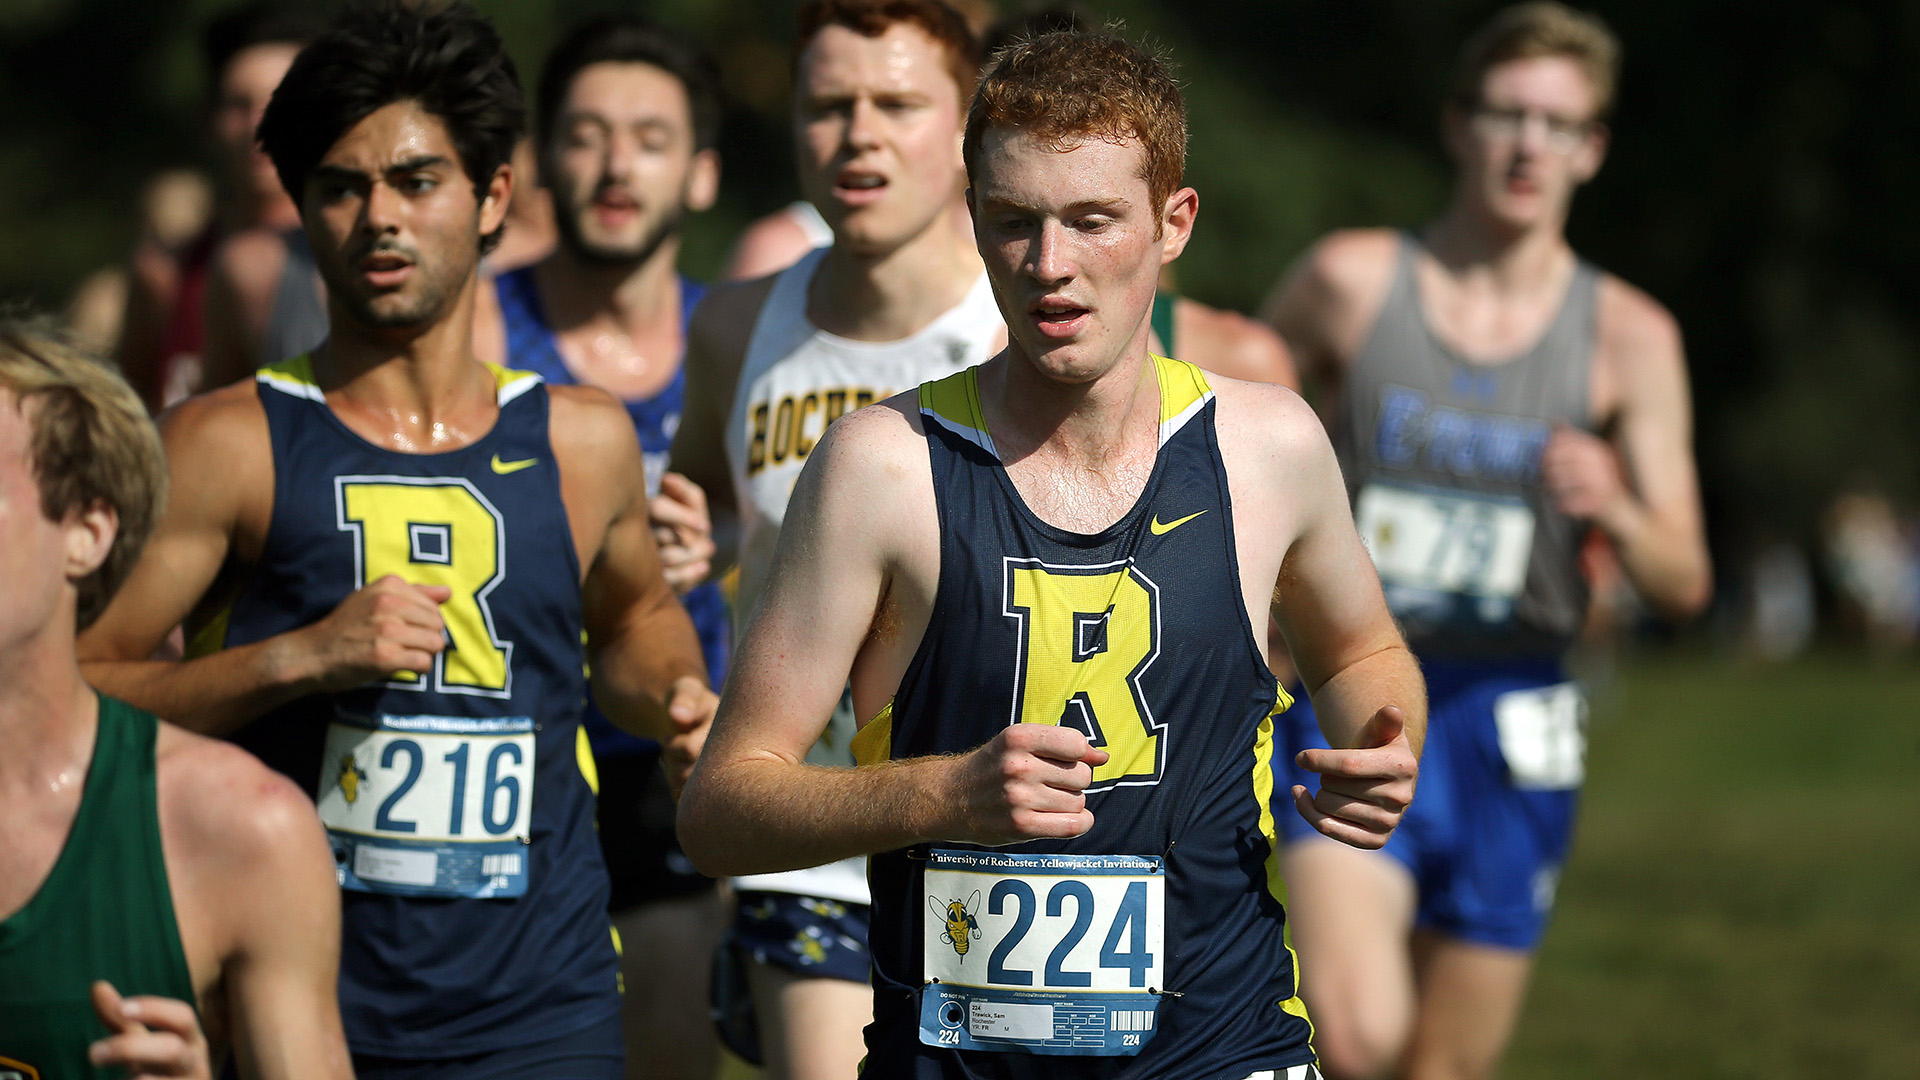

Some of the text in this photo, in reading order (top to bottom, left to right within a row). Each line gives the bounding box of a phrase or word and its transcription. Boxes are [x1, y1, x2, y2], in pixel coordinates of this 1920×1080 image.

[747, 384, 893, 477] ROCH
[334, 475, 514, 699] R
[1002, 556, 1169, 794] R
[374, 739, 523, 835] 216
[979, 856, 990, 866] of
[990, 857, 1039, 868] Rochester
[1040, 858, 1102, 870] Yellowjacket
[1103, 859, 1159, 869] Invitational
[986, 878, 1154, 988] 224
[938, 1030, 960, 1045] 224
[1122, 1034, 1140, 1046] 224
